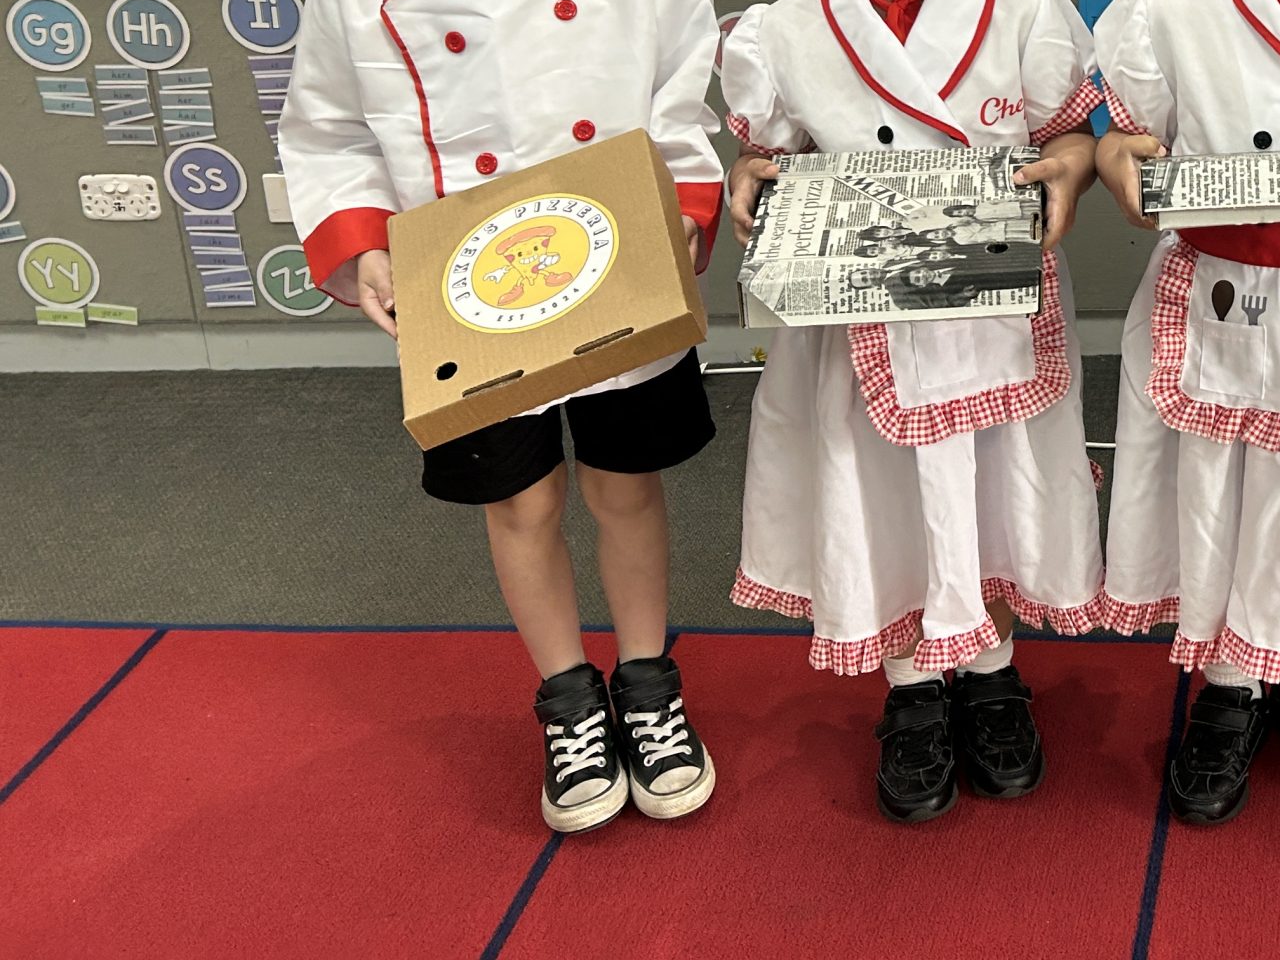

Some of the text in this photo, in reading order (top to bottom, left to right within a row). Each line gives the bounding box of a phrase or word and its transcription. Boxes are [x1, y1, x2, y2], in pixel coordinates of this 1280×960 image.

[22, 13, 75, 55] Gg
[122, 10, 172, 47] Hh
[980, 97, 1026, 127] Che
[182, 163, 227, 194] Ss
[799, 180, 826, 209] pizza
[764, 180, 796, 259] the search for the
[788, 211, 816, 257] perfect
[452, 199, 609, 301] JAKE'S PIZZERIA
[30, 257, 80, 292] Yy
[497, 288, 579, 322] EST 2024
